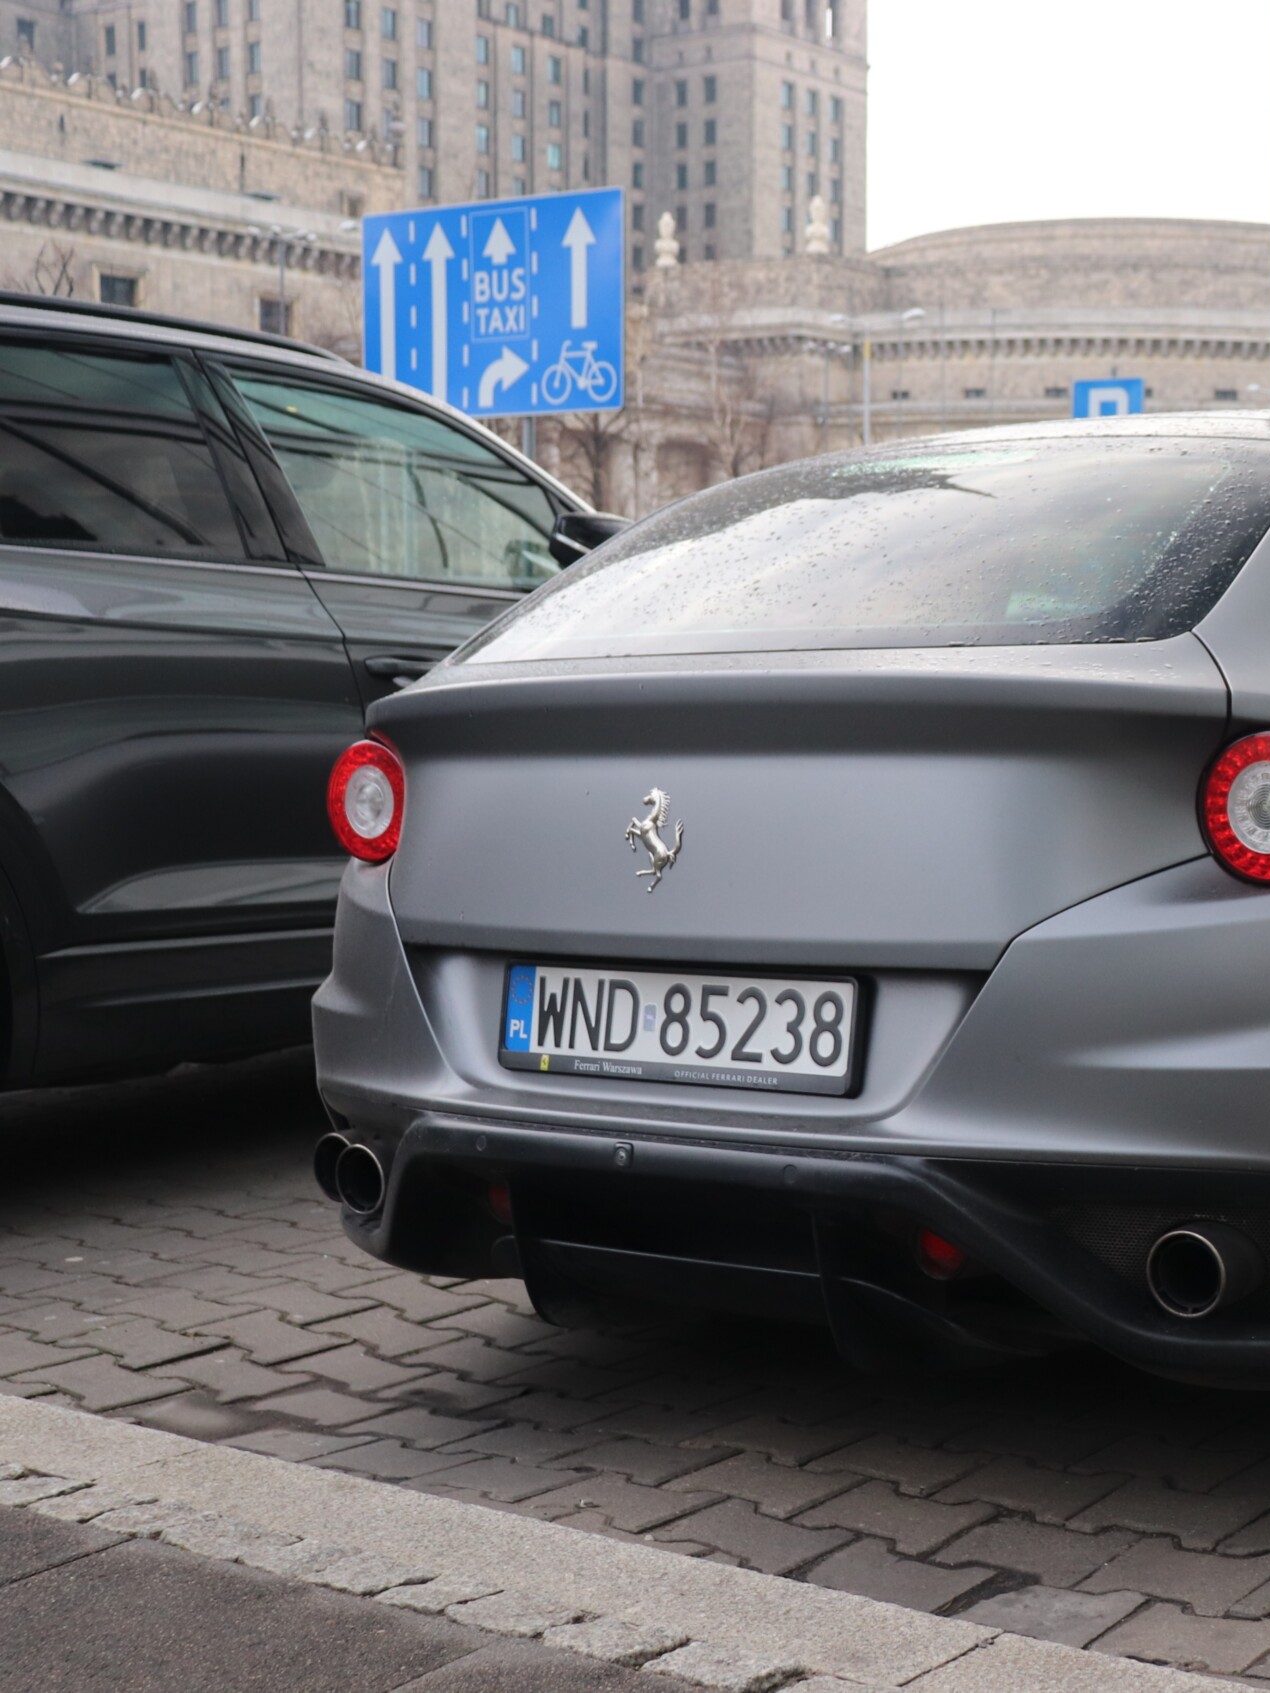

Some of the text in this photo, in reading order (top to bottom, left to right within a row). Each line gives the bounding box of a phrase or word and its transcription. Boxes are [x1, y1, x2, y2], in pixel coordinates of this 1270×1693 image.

[474, 267, 526, 304] BUS
[476, 308, 525, 336] TAXI
[509, 1019, 529, 1040] PL
[537, 976, 845, 1067] WND 85238
[573, 1059, 779, 1085] Ferrari Warszawa OFFICIAL FERRARI DEALER
